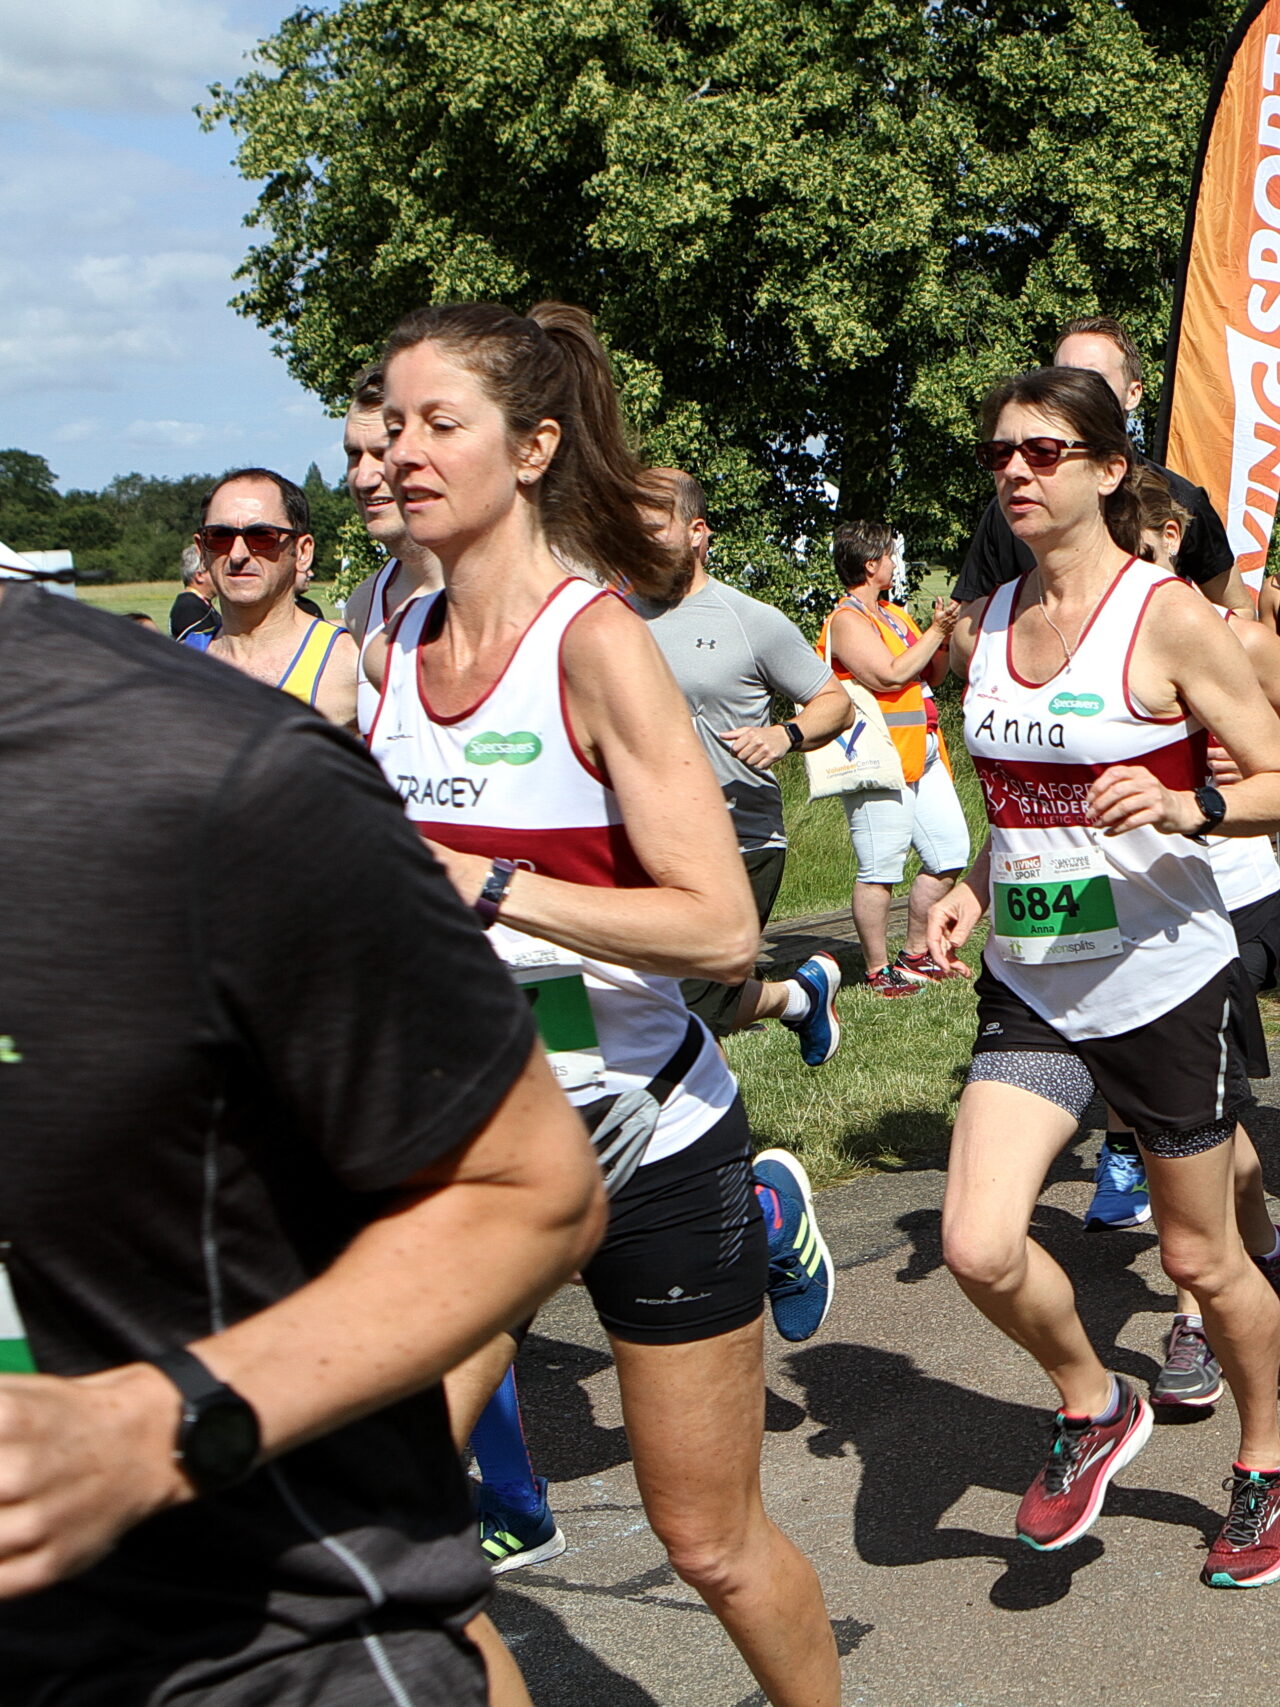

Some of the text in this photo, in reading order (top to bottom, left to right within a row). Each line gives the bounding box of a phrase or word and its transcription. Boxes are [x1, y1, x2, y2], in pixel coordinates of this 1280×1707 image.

[974, 709, 1066, 750] Anna
[397, 774, 488, 807] TRACEY
[1021, 796, 1090, 815] STRIDER
[1013, 857, 1041, 871] LIVING
[1014, 868, 1041, 881] SPORT
[1007, 884, 1080, 921] 684
[1030, 924, 1056, 934] Anna
